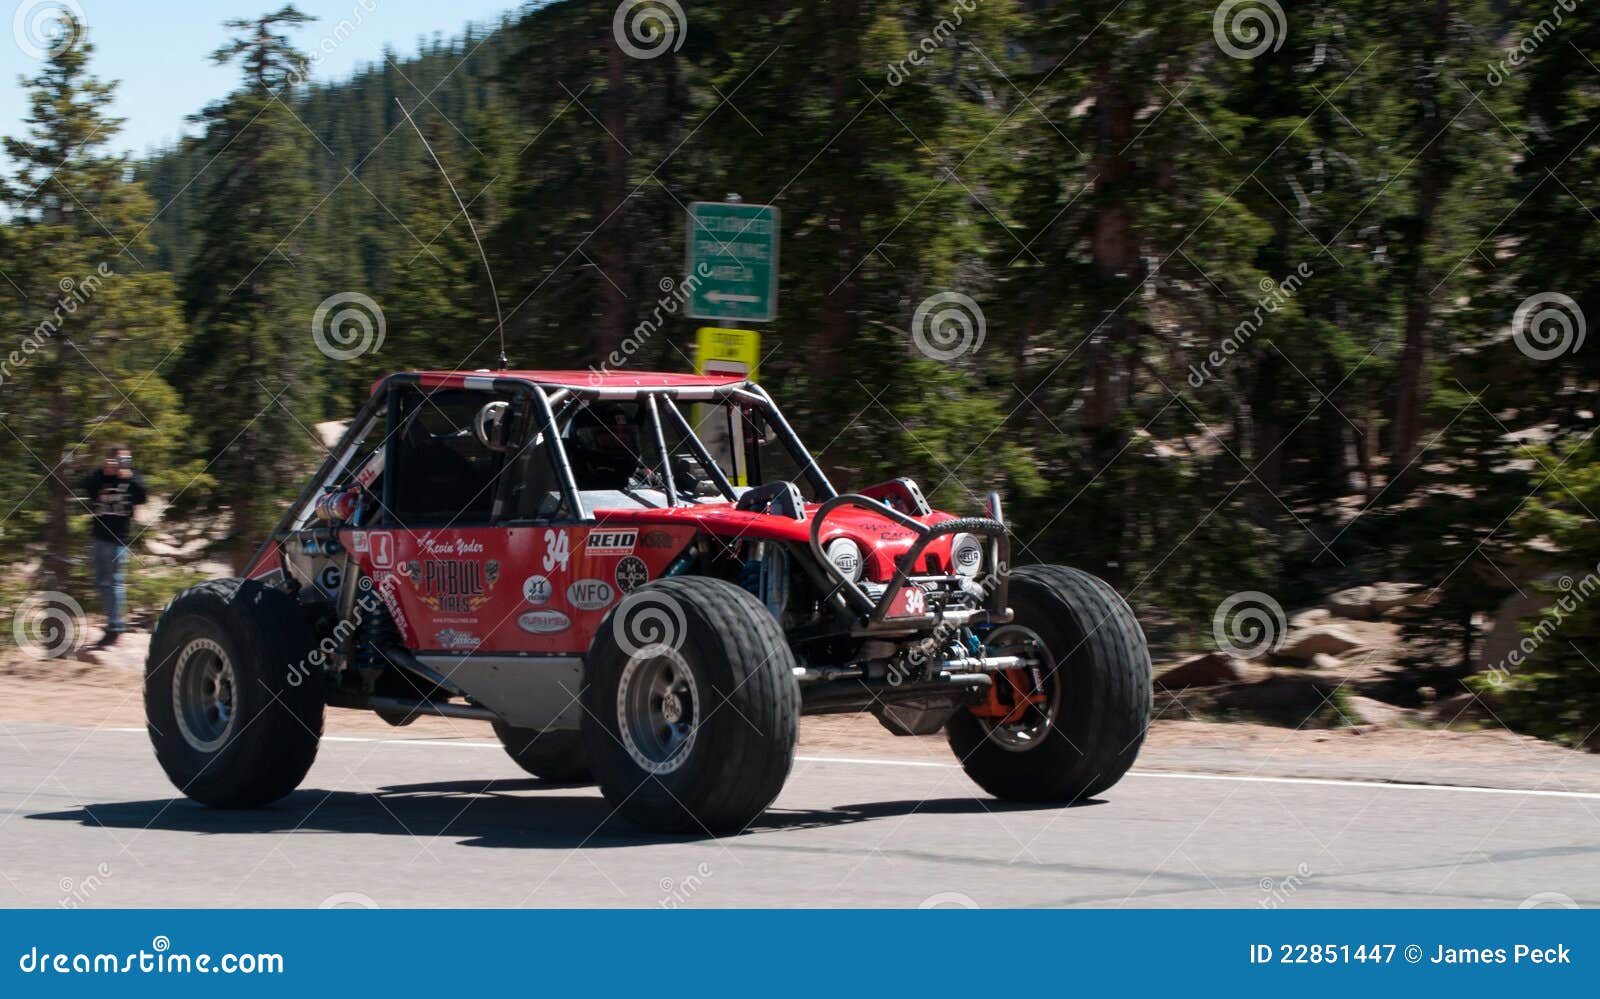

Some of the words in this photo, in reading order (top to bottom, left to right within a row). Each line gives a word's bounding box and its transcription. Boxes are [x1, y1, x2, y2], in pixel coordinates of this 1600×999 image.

[456, 538, 484, 556] Yoder
[588, 533, 636, 547] REID
[543, 529, 569, 572] 34
[959, 550, 979, 560] HELLA
[836, 560, 858, 569] HELLA
[425, 560, 485, 595] PITBULL
[618, 572, 645, 580] BLACK
[572, 584, 610, 602] WFO
[904, 589, 925, 614] 34
